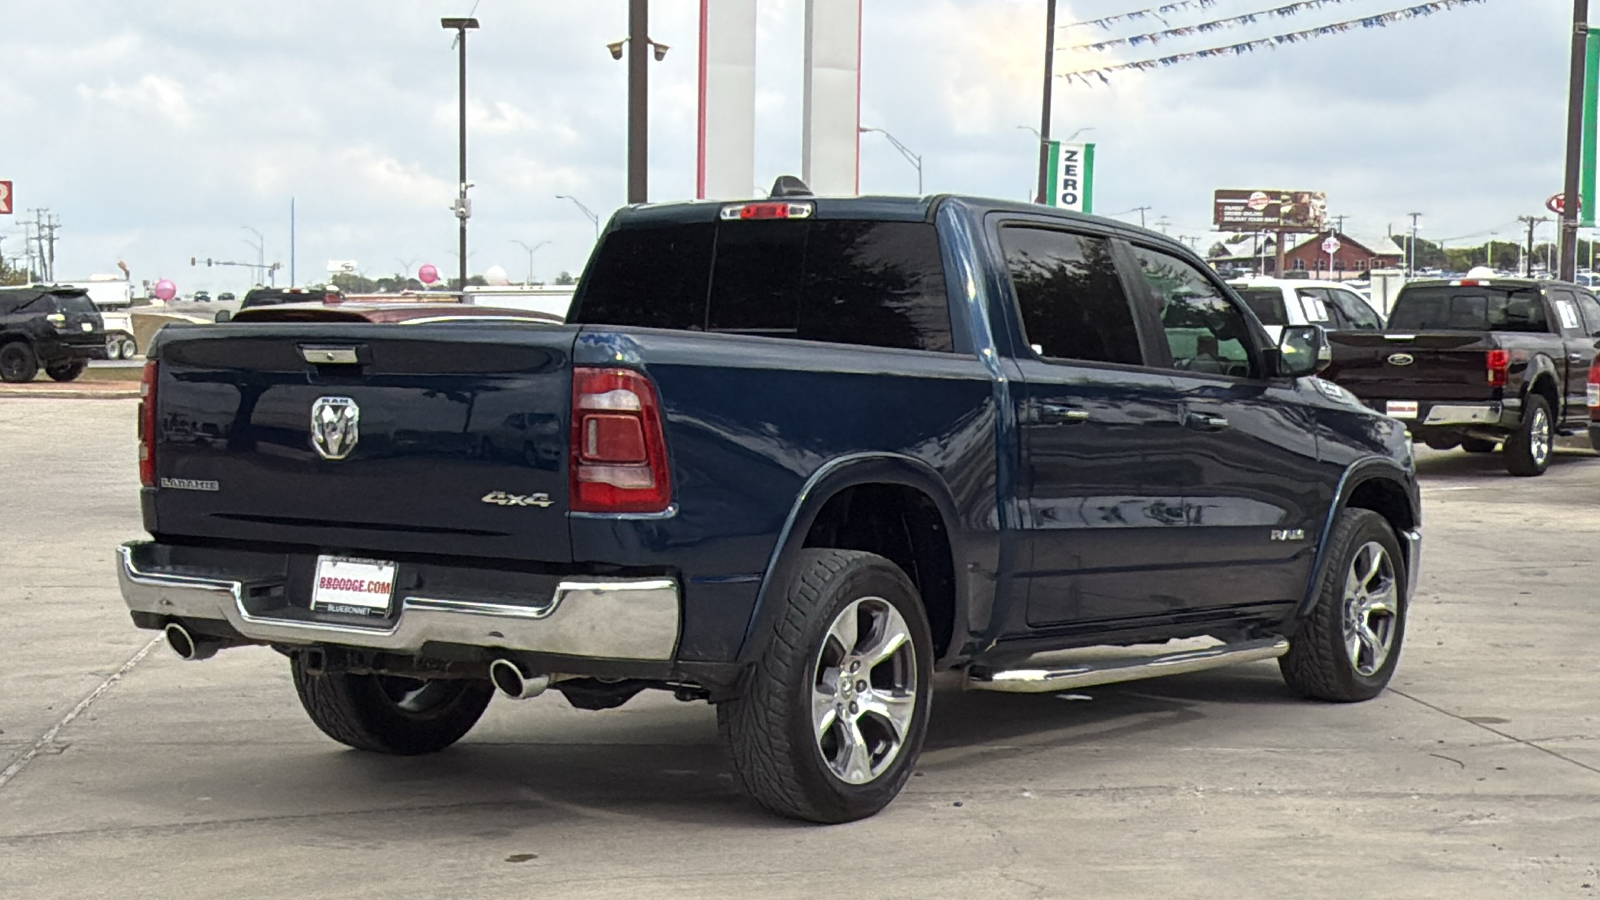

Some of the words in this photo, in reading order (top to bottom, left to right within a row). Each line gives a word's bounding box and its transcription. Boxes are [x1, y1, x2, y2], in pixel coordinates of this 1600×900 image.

[1061, 150, 1078, 205] ZERO
[1270, 529, 1305, 541] RAM
[319, 577, 390, 594] BBDODGE.COM
[327, 604, 372, 615] BLUEBONNET
